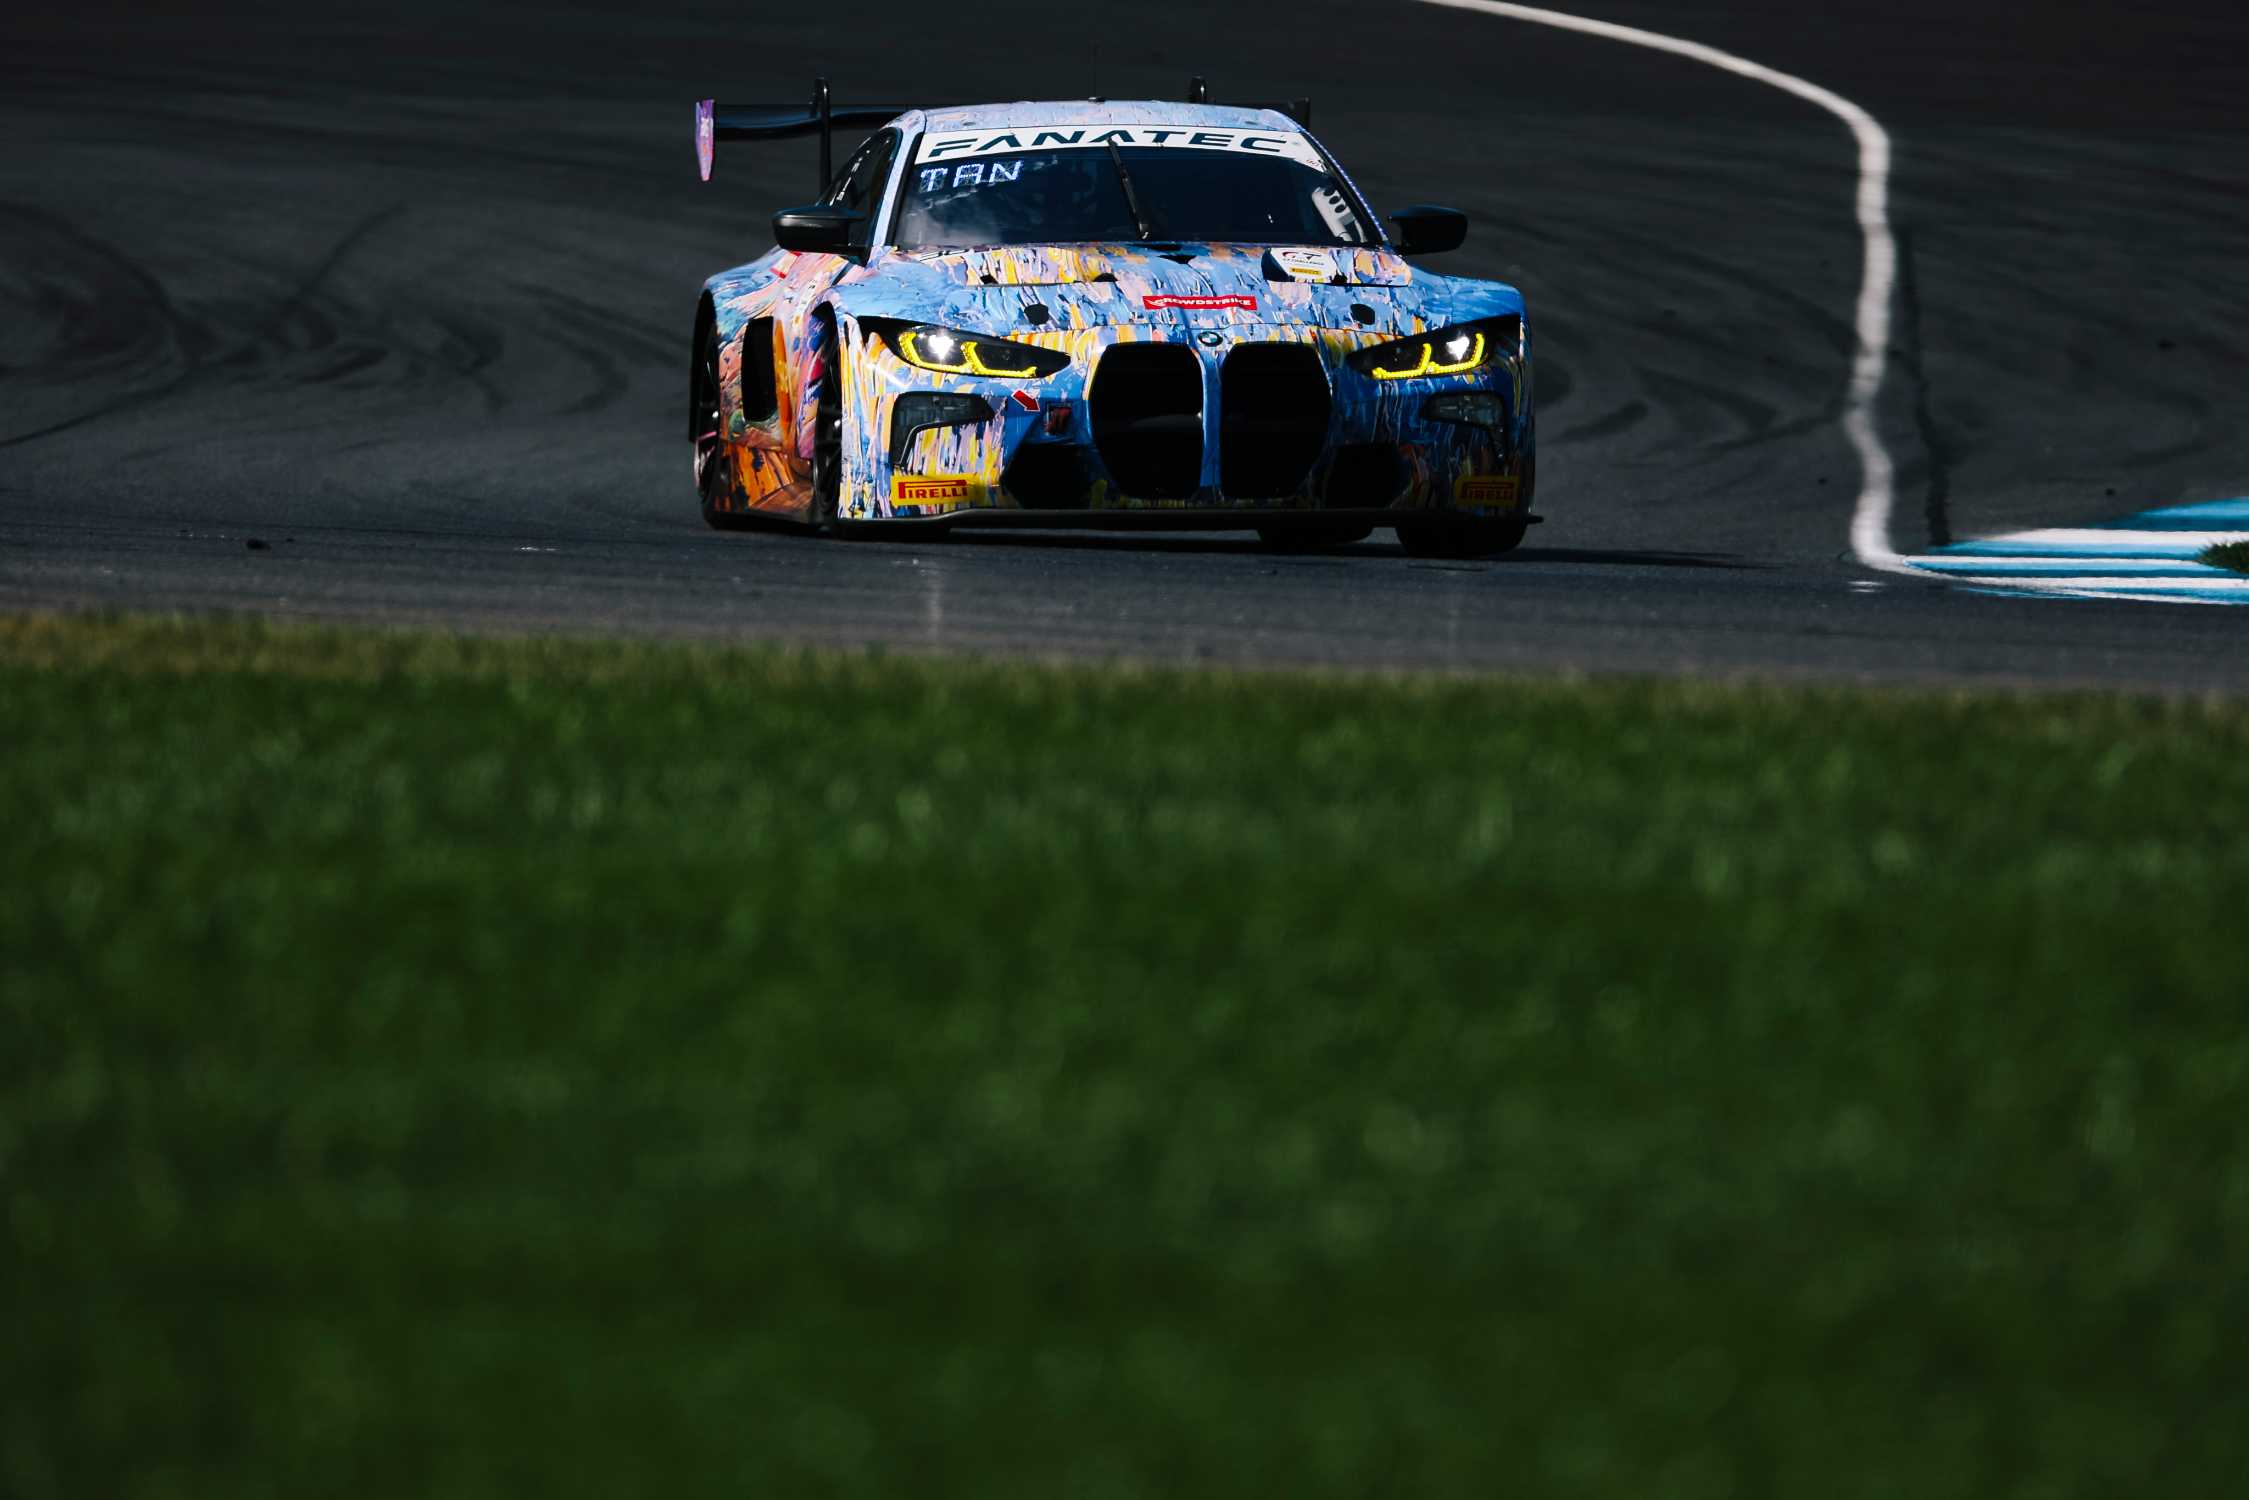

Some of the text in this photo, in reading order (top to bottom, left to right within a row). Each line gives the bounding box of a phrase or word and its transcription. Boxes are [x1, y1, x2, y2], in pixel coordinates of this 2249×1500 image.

[928, 130, 1287, 157] FANATEC
[920, 160, 1024, 192] TAN
[898, 480, 967, 499] PIRELLI
